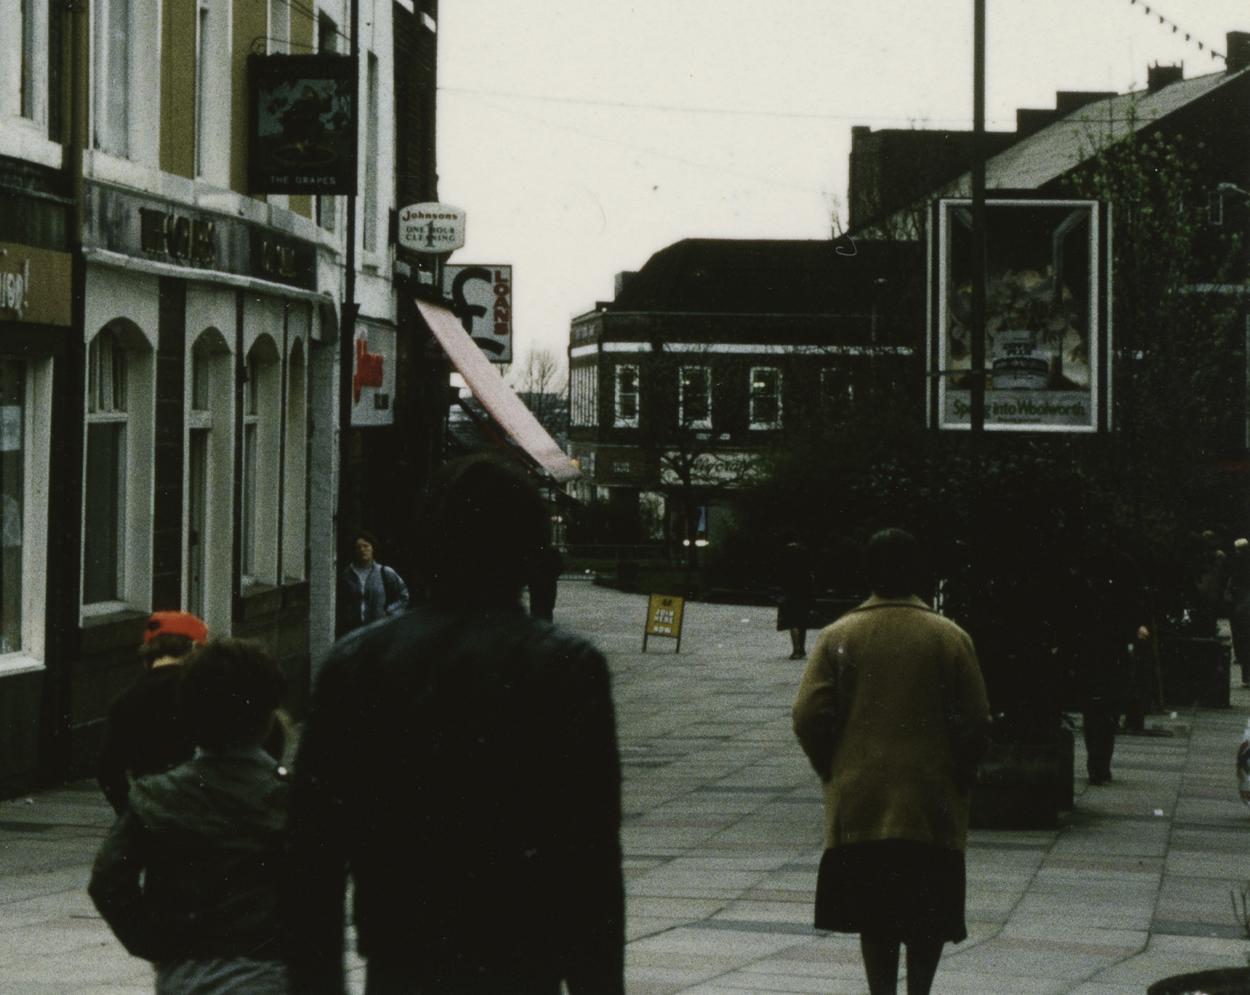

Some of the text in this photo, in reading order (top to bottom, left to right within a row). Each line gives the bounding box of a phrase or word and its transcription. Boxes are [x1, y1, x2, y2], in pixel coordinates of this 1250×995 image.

[270, 175, 336, 185] THE GRAPES
[402, 211, 458, 221] Johnsons
[406, 226, 424, 234] ONE
[406, 234, 456, 242] CLEANING
[493, 269, 510, 336] LOANS
[992, 402, 1016, 415] into
